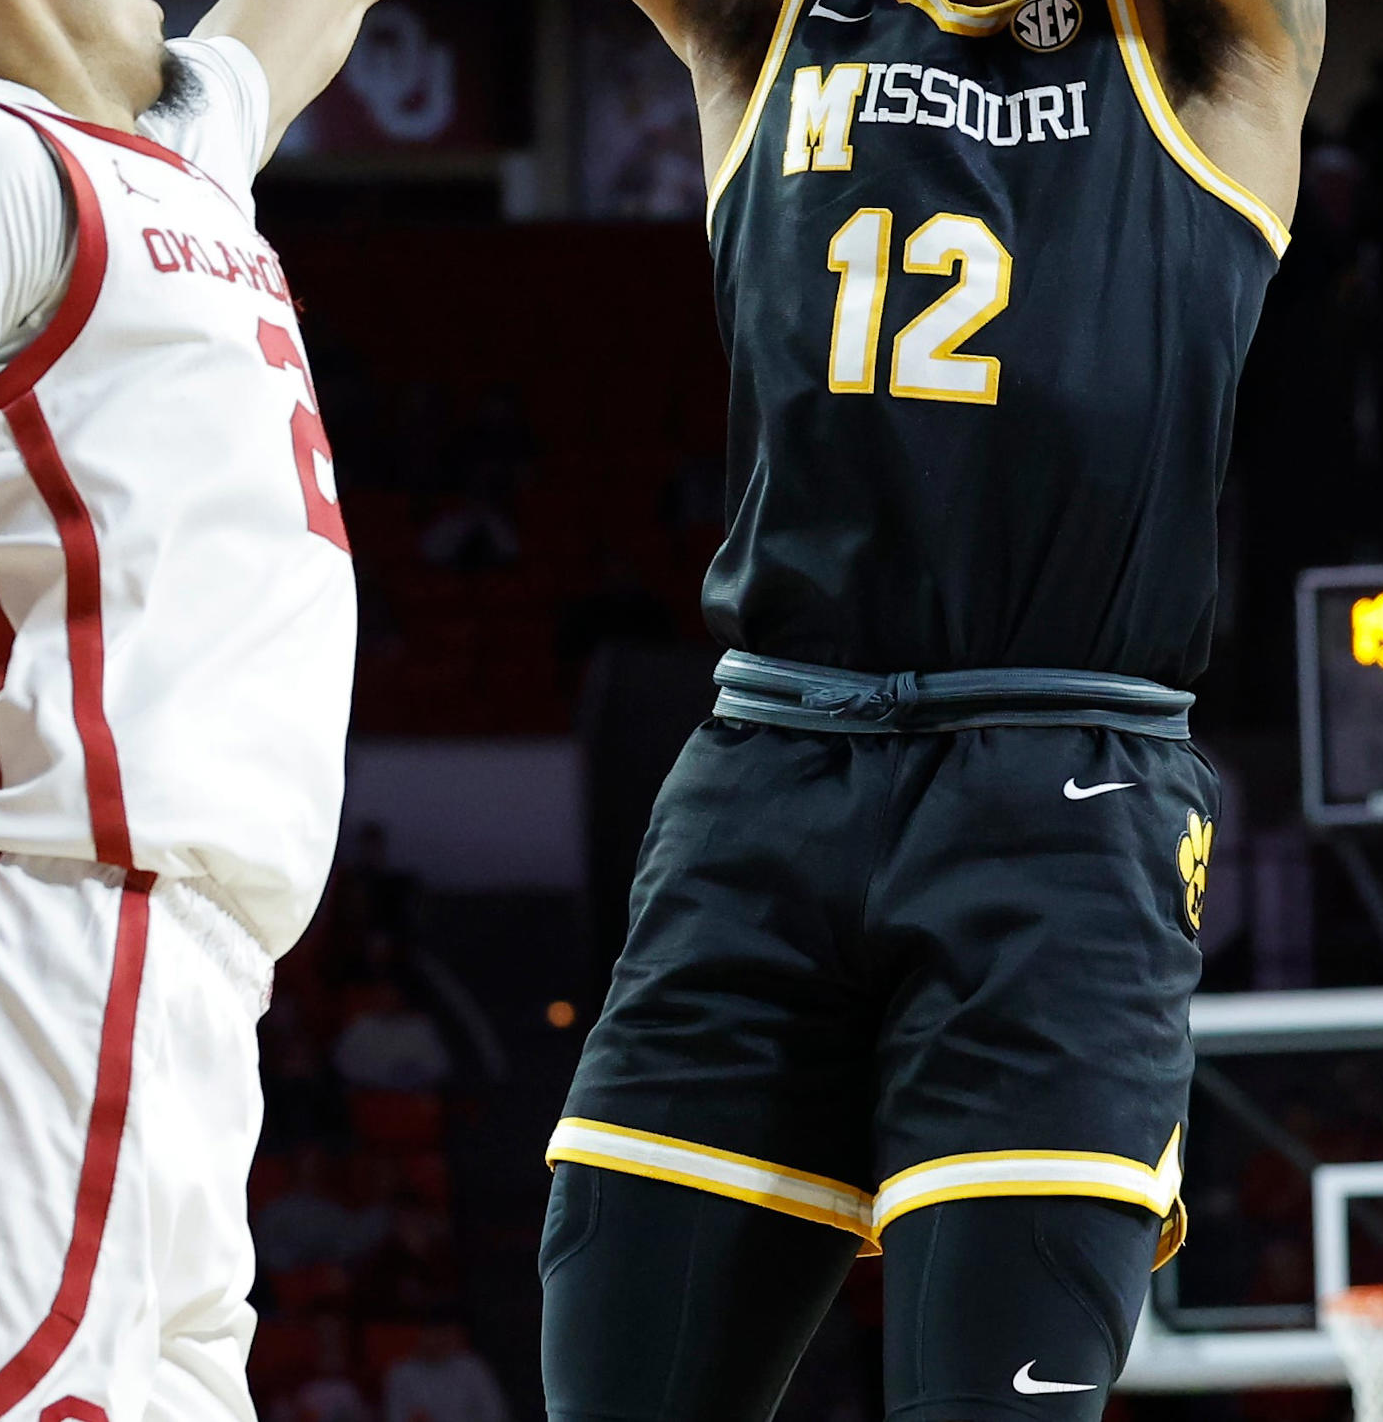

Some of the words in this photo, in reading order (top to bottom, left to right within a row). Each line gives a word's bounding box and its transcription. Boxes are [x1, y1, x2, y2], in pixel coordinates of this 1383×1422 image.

[783, 63, 1090, 176] MISSOURI
[142, 228, 290, 305] OKLAHO
[827, 208, 1013, 405] 12
